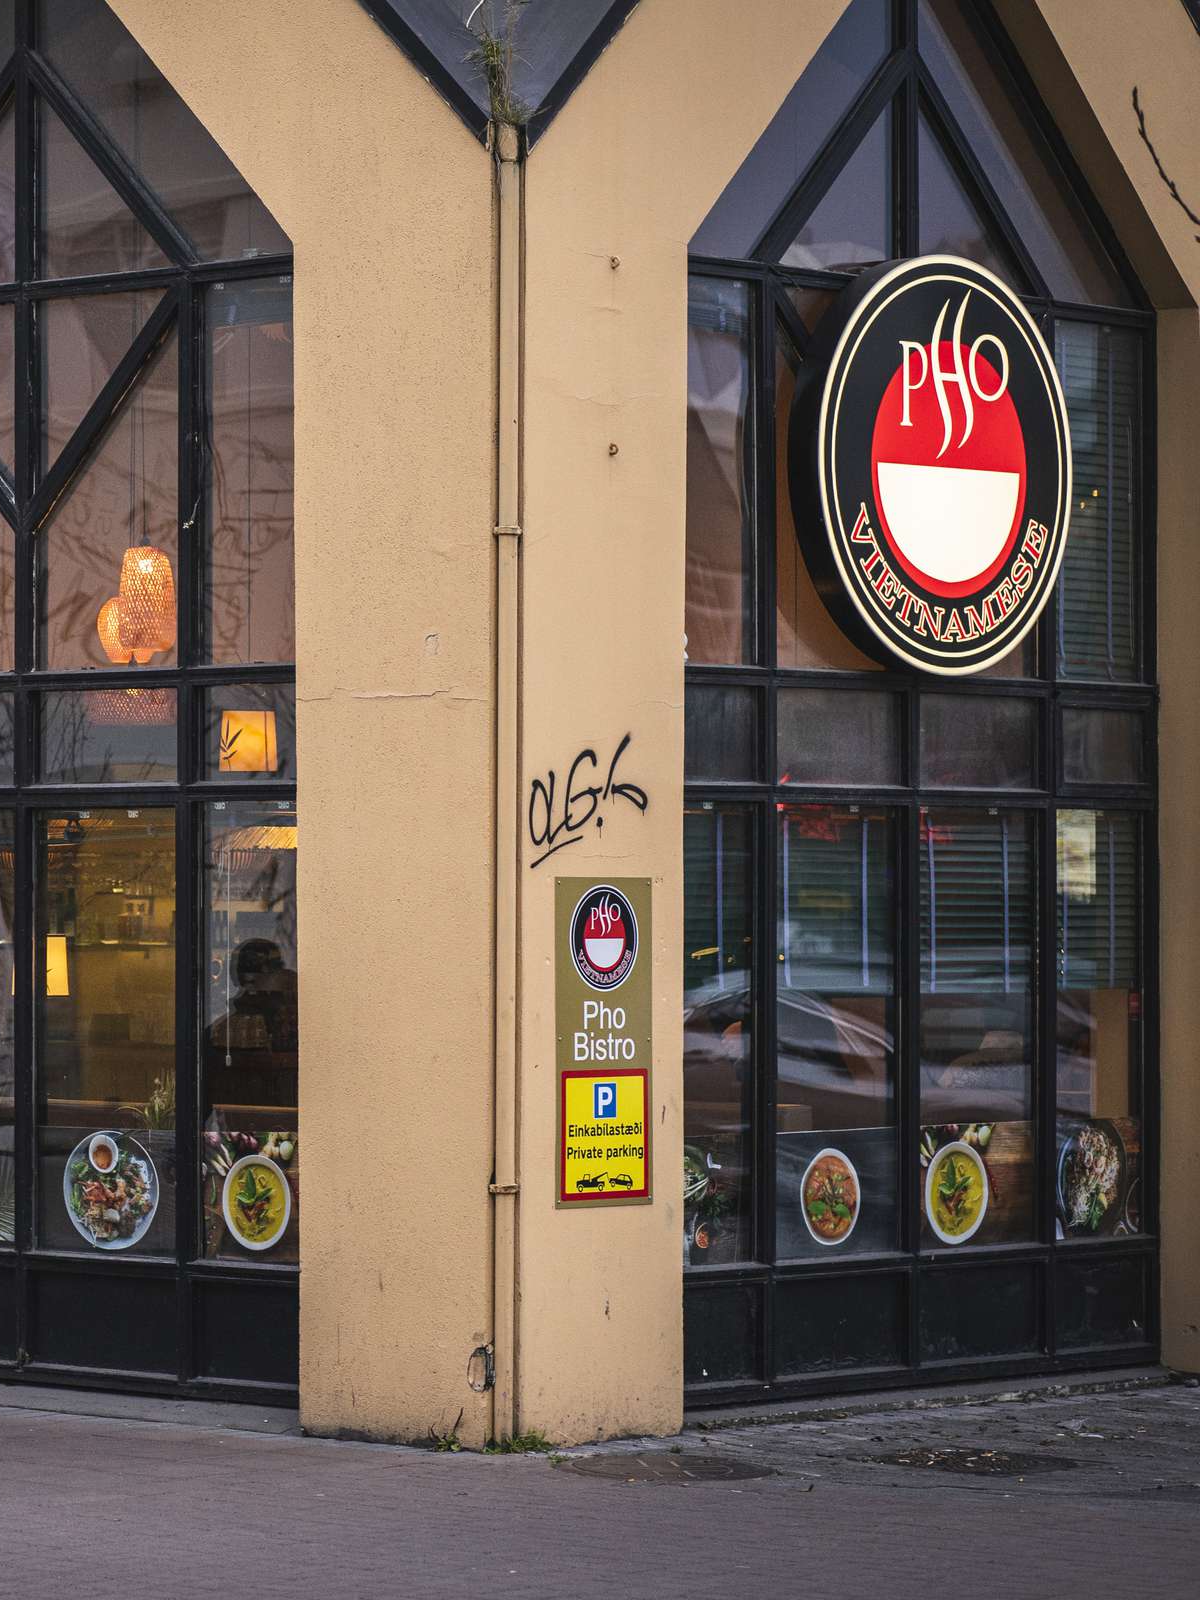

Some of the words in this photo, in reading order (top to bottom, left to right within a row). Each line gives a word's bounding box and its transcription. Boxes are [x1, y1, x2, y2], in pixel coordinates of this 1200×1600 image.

[898, 288, 1010, 460] PHO
[849, 501, 1049, 643] VIETNAMESE
[590, 893, 621, 937] PHO
[577, 948, 633, 984] VIETNAMESE
[583, 1000, 626, 1030] Pho
[574, 1032, 636, 1061] Bistro
[598, 1086, 613, 1116] P
[567, 1146, 603, 1160] Private
[606, 1144, 644, 1160] parking
